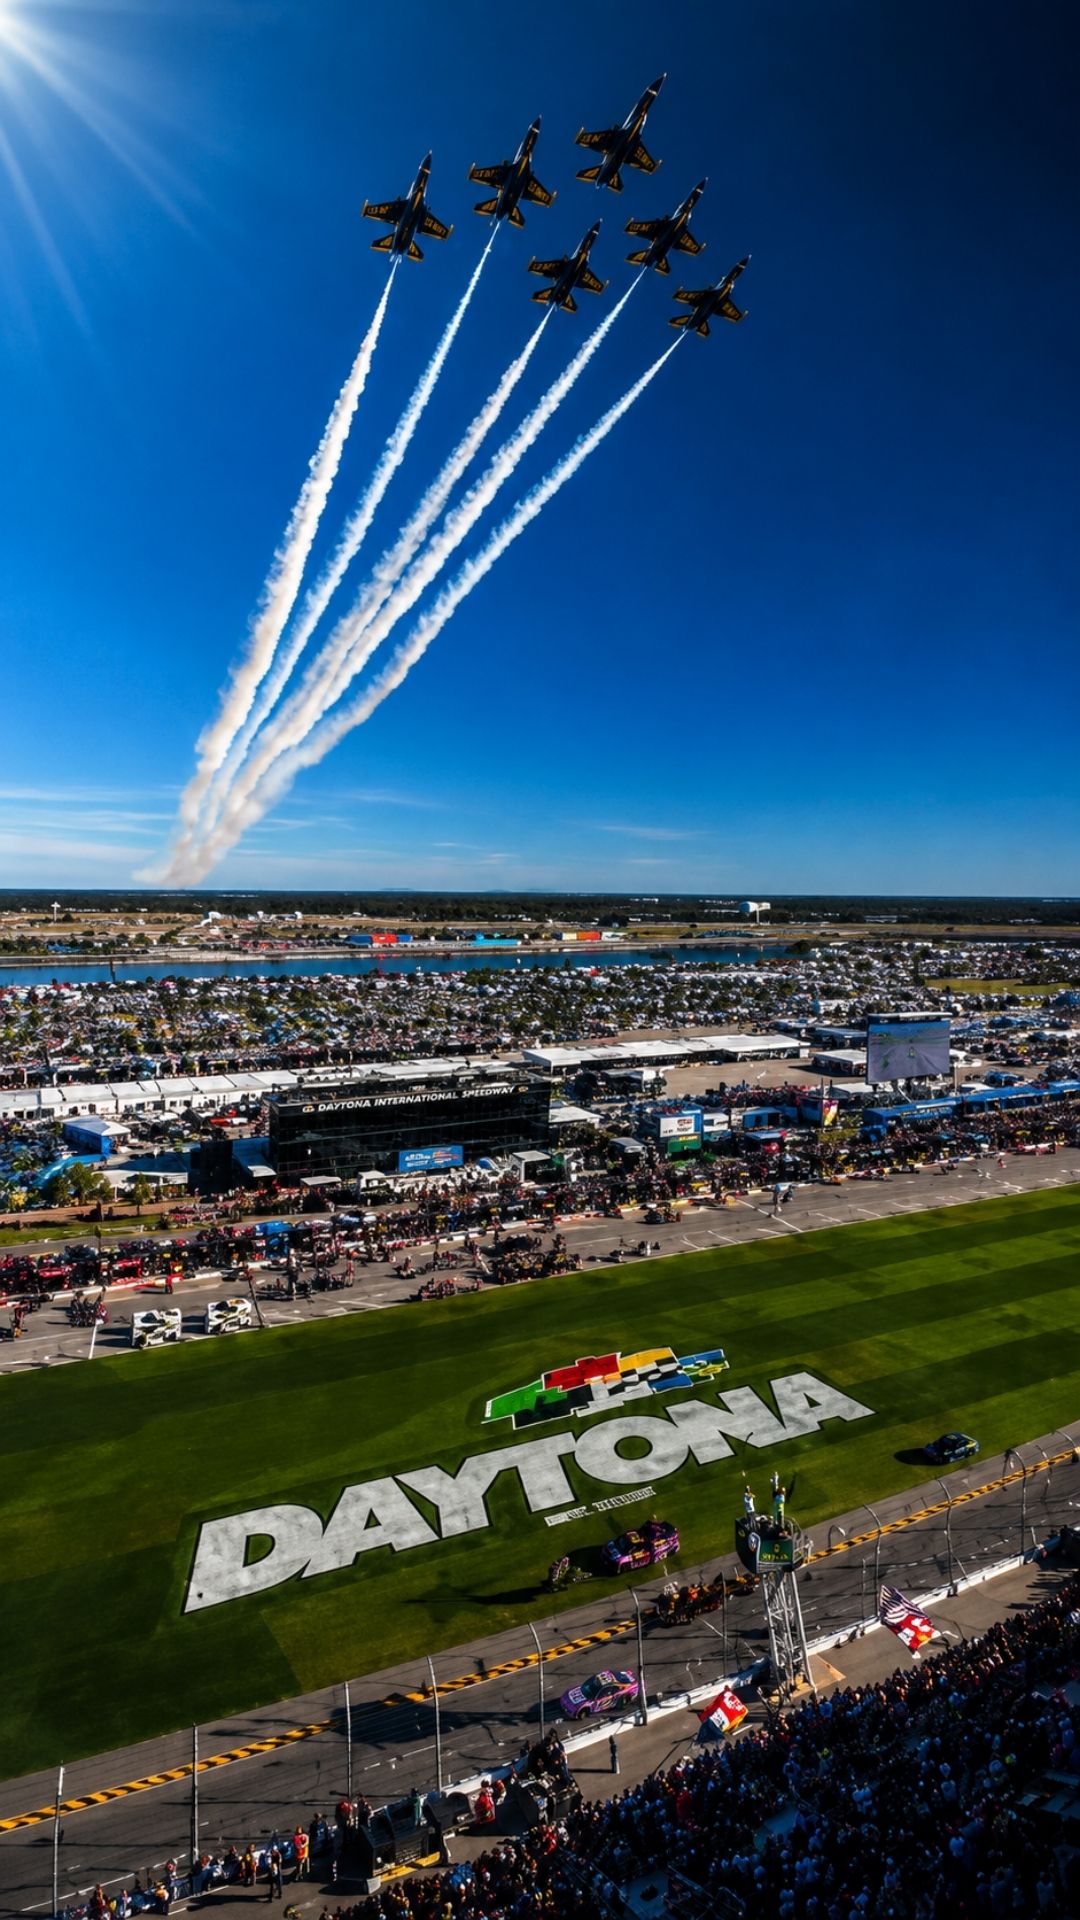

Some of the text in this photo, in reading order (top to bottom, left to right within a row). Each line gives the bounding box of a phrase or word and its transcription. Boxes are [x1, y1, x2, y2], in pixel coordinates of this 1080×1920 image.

[318, 1085, 515, 1112] DAYTONA INTERNATIONAL SPEEDWAY
[184, 1372, 874, 1614] DAYTONA
